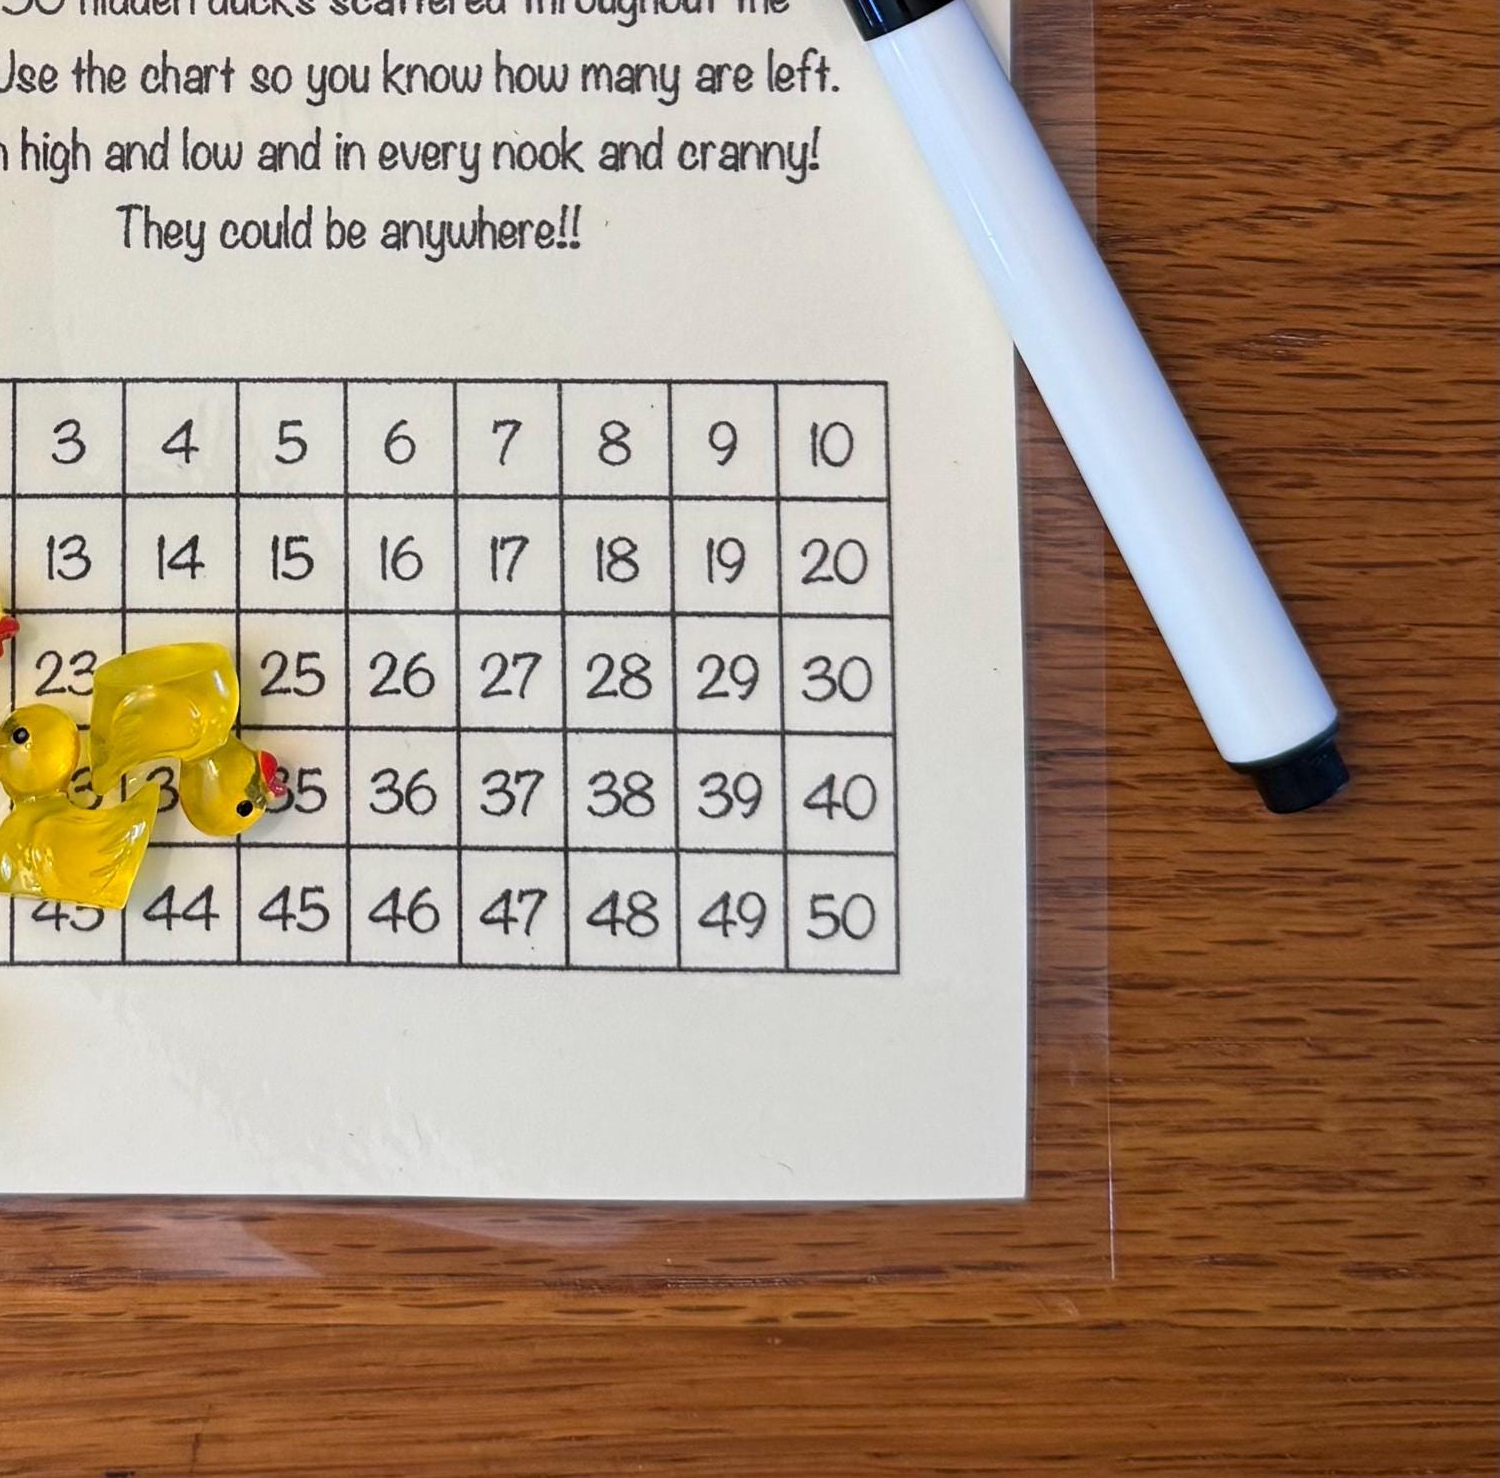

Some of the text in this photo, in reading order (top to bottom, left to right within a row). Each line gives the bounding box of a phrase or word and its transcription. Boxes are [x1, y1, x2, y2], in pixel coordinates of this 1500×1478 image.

[71, 49, 126, 94] the
[140, 49, 235, 95] chart
[250, 64, 292, 94] so
[306, 64, 370, 106] you
[383, 49, 482, 95] know
[495, 49, 569, 93] how
[581, 63, 680, 106] many
[695, 63, 754, 94] are
[767, 47, 840, 92] left.
[21, 126, 91, 183] high
[105, 126, 170, 173] and
[182, 126, 243, 171] low
[258, 126, 321, 172] and
[336, 132, 365, 170] in
[378, 141, 481, 183] every
[493, 126, 584, 173] nook
[598, 126, 664, 172] and
[677, 126, 821, 184] cranny!
[116, 204, 582, 262] They could be anywhere!!
[52, 419, 86, 464] 3
[161, 419, 199, 464] 4
[275, 420, 307, 464] 5
[384, 419, 416, 465] 6
[492, 419, 522, 466] 7
[598, 420, 631, 466] 8
[709, 421, 737, 466] 9
[810, 422, 854, 467] 10
[47, 534, 91, 581] 13
[157, 534, 205, 580] 14
[272, 535, 314, 580] 15
[380, 535, 423, 581] 16
[491, 535, 529, 582] 17
[596, 536, 639, 583] 18
[707, 537, 745, 584] 19
[801, 538, 868, 585] 20
[35, 650, 95, 697] 23
[260, 650, 326, 698] 25
[369, 651, 435, 698] 26
[480, 652, 542, 699] 27
[587, 652, 652, 700] 28
[697, 654, 759, 701] 29
[802, 655, 873, 702] 30
[369, 768, 437, 816] 36
[480, 769, 544, 817] 37
[587, 770, 655, 818] 38
[698, 772, 762, 819] 39
[803, 773, 877, 821] 40
[142, 884, 220, 931] 44
[258, 885, 330, 932] 45
[368, 886, 440, 934] 46
[480, 888, 548, 936] 47
[586, 890, 659, 938] 48
[698, 891, 767, 939] 49
[807, 893, 876, 940] 50
